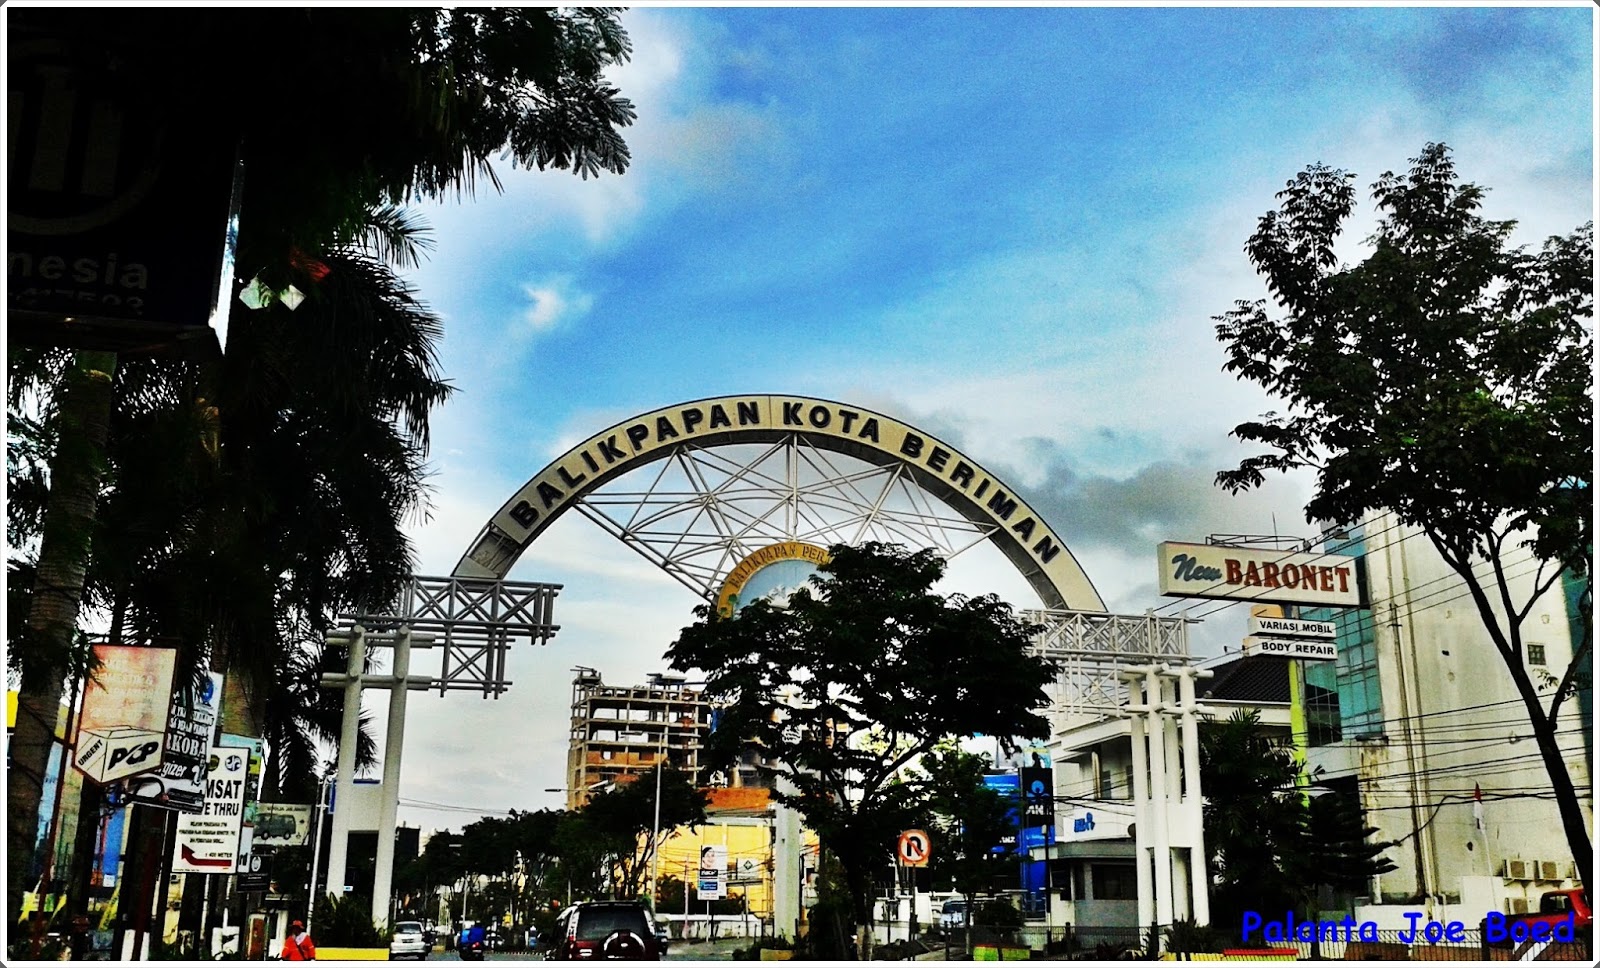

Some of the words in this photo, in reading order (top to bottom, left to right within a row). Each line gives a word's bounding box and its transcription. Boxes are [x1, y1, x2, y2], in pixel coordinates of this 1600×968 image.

[507, 401, 761, 530] BALIKPAPAN
[782, 402, 882, 443] KOTA
[900, 431, 1061, 564] BERIMAN
[728, 544, 797, 589] BALIKPAPAN
[1171, 554, 1223, 582] New
[1225, 558, 1351, 593] BARONET
[1259, 620, 1299, 632] VARIASI
[1302, 622, 1333, 634] MOBIL
[1261, 641, 1291, 653] BODY
[1295, 644, 1335, 656] REPAIR
[77, 739, 104, 766] URGENT
[160, 760, 188, 778] gizer
[214, 802, 240, 816] THRU
